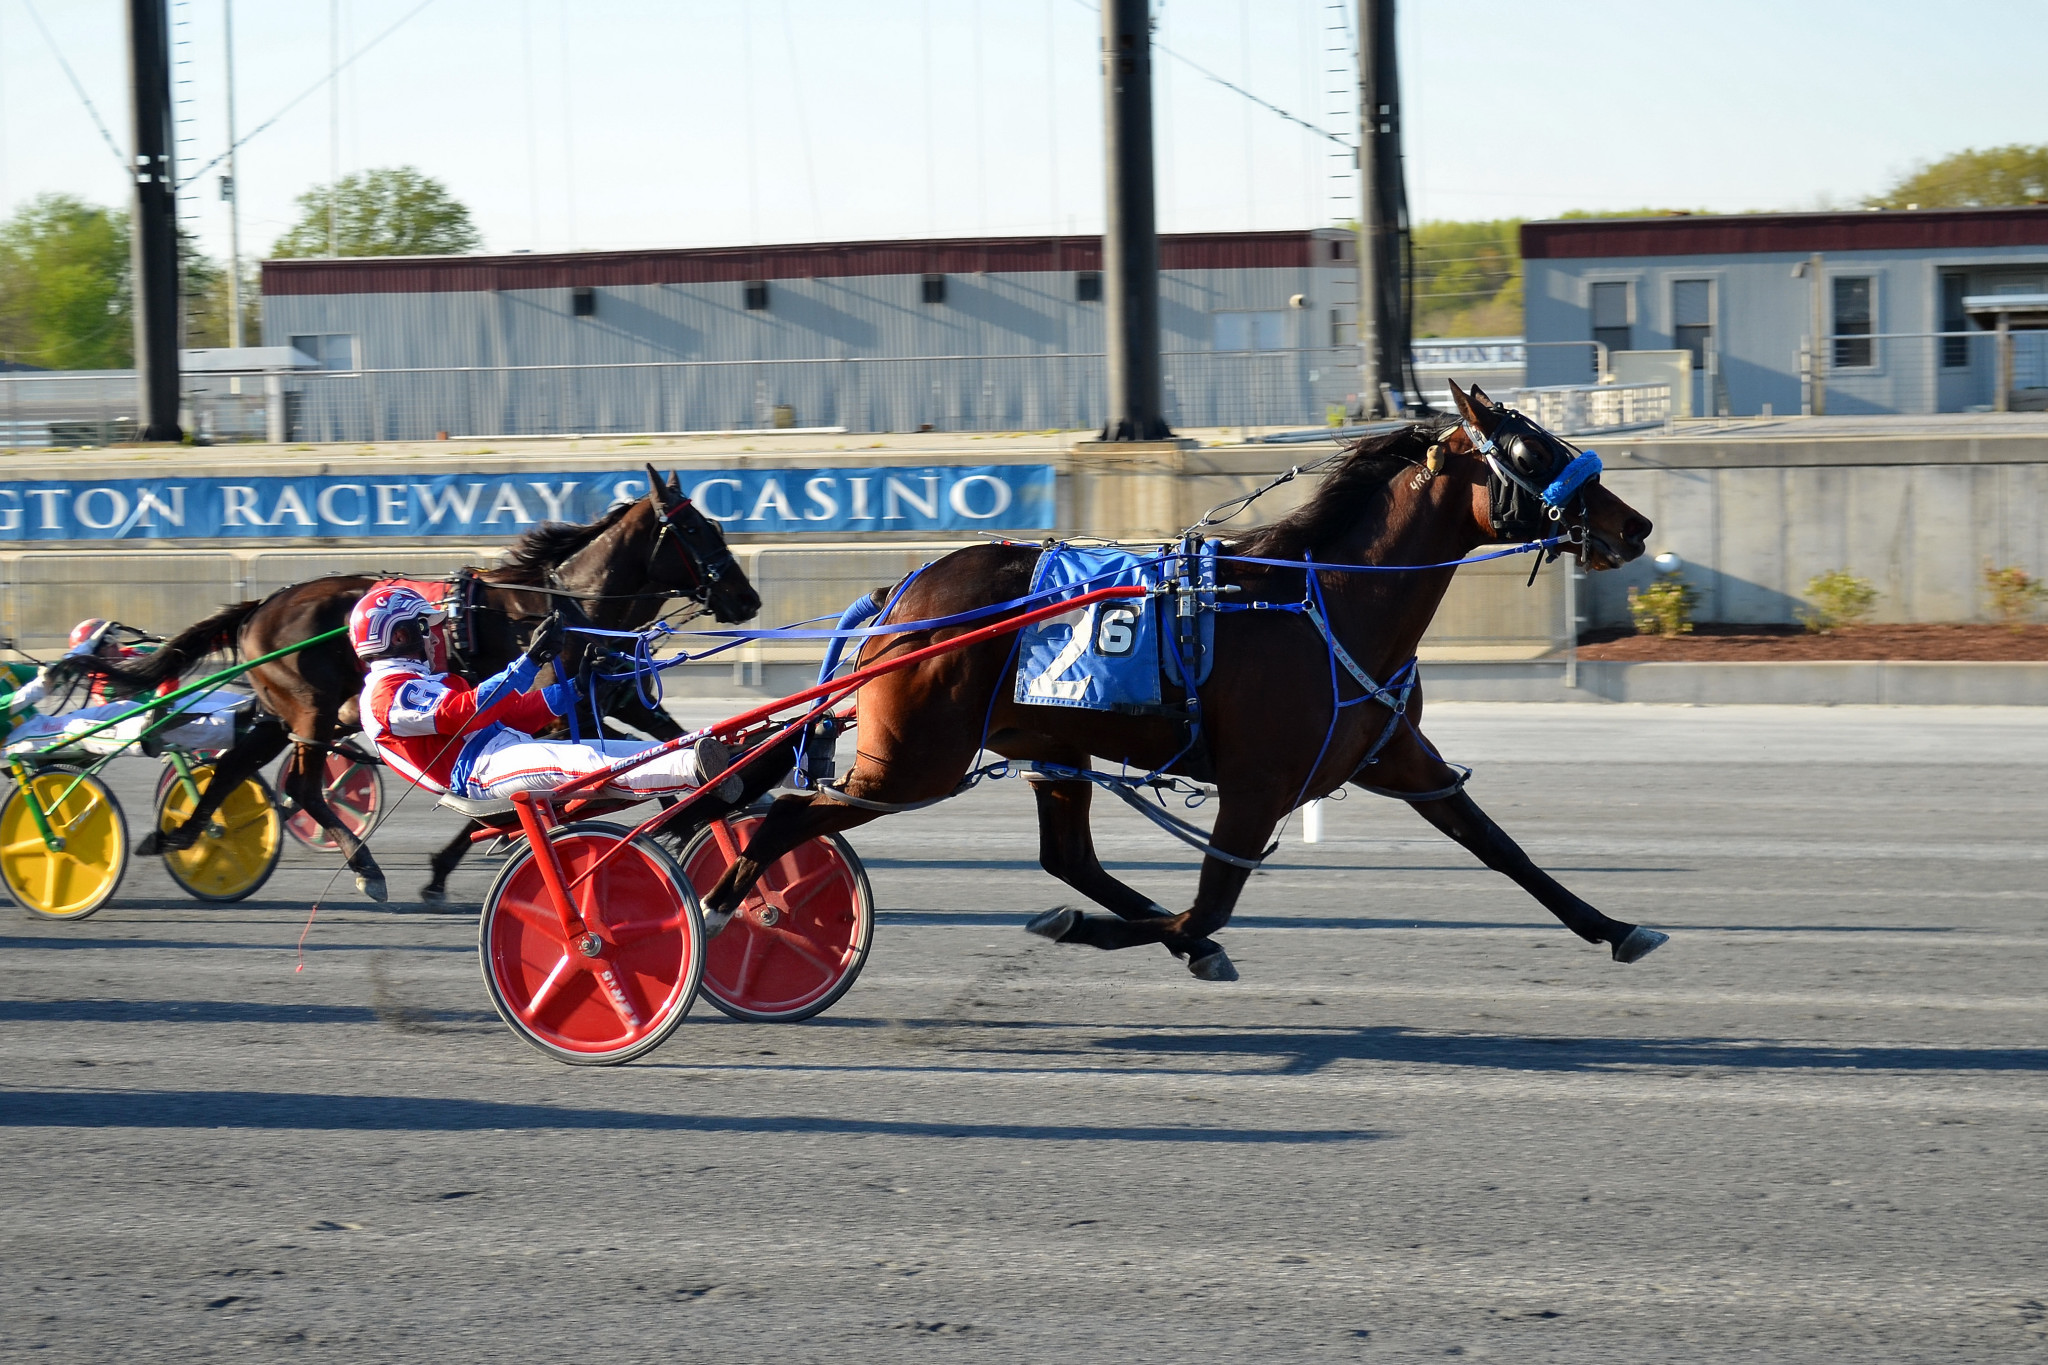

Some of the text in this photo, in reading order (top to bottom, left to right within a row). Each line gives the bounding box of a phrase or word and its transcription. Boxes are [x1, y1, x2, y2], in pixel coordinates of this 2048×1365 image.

[218, 482, 582, 526] RACEWAY
[689, 475, 1013, 523] CASINO
[1028, 608, 1093, 700] 2
[1099, 609, 1135, 653] 6
[611, 725, 713, 773] MICHAEL COLE
